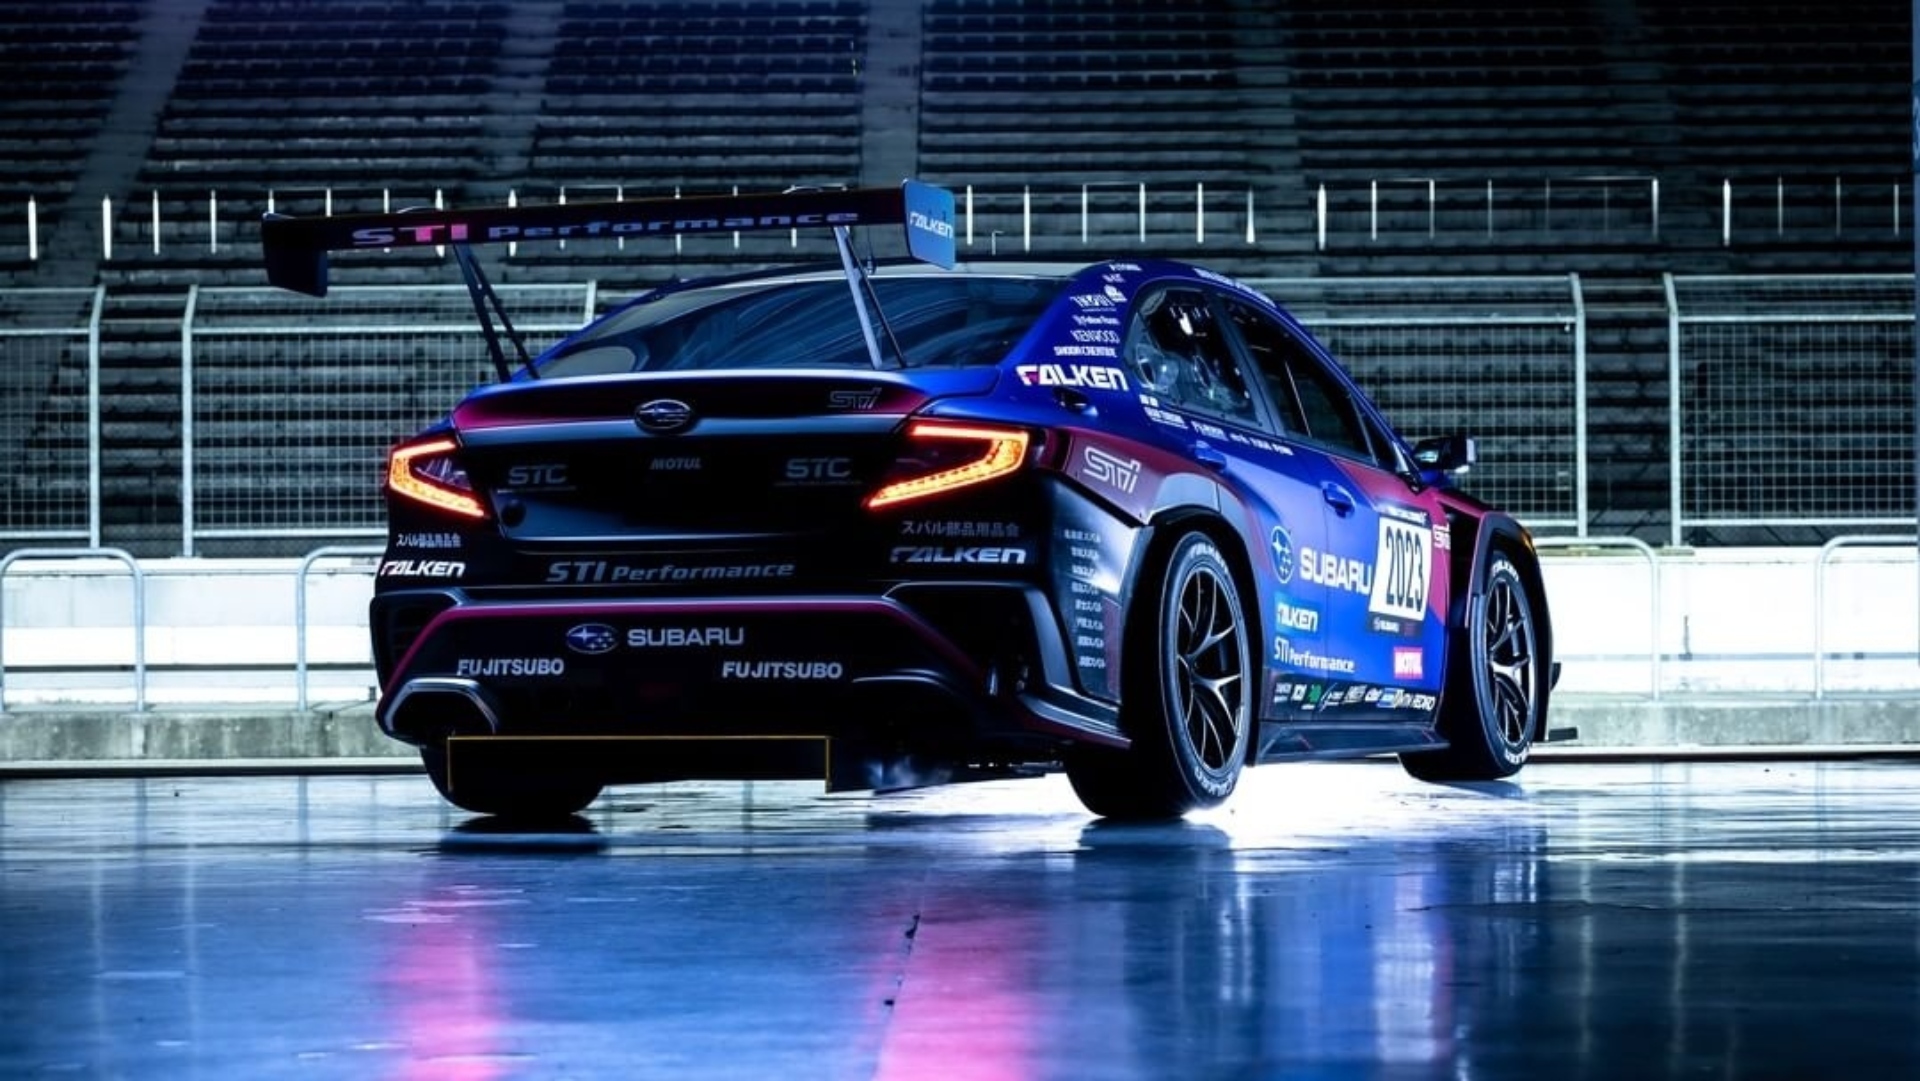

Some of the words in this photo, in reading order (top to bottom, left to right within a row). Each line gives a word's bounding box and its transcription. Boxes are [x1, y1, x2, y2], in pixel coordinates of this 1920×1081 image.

[351, 222, 469, 246] STI
[487, 212, 859, 240] Performance
[909, 211, 954, 239] FALKEN
[1015, 364, 1129, 391] FALKEN
[508, 463, 570, 485] STC
[649, 456, 704, 471] MOTUL
[784, 457, 853, 479] STC
[889, 547, 1026, 564] FALKEN
[380, 559, 466, 577] FALKEN
[546, 560, 608, 582] STI
[611, 563, 797, 582] Performance
[1300, 547, 1372, 595] SUBARU
[1386, 526, 1424, 612] 2023
[627, 627, 744, 647] SUBARU
[1274, 636, 1289, 663] STI
[1289, 646, 1356, 673] Performance
[457, 658, 565, 676] FUJITSUBO
[722, 661, 843, 679] FUJITSUBO
